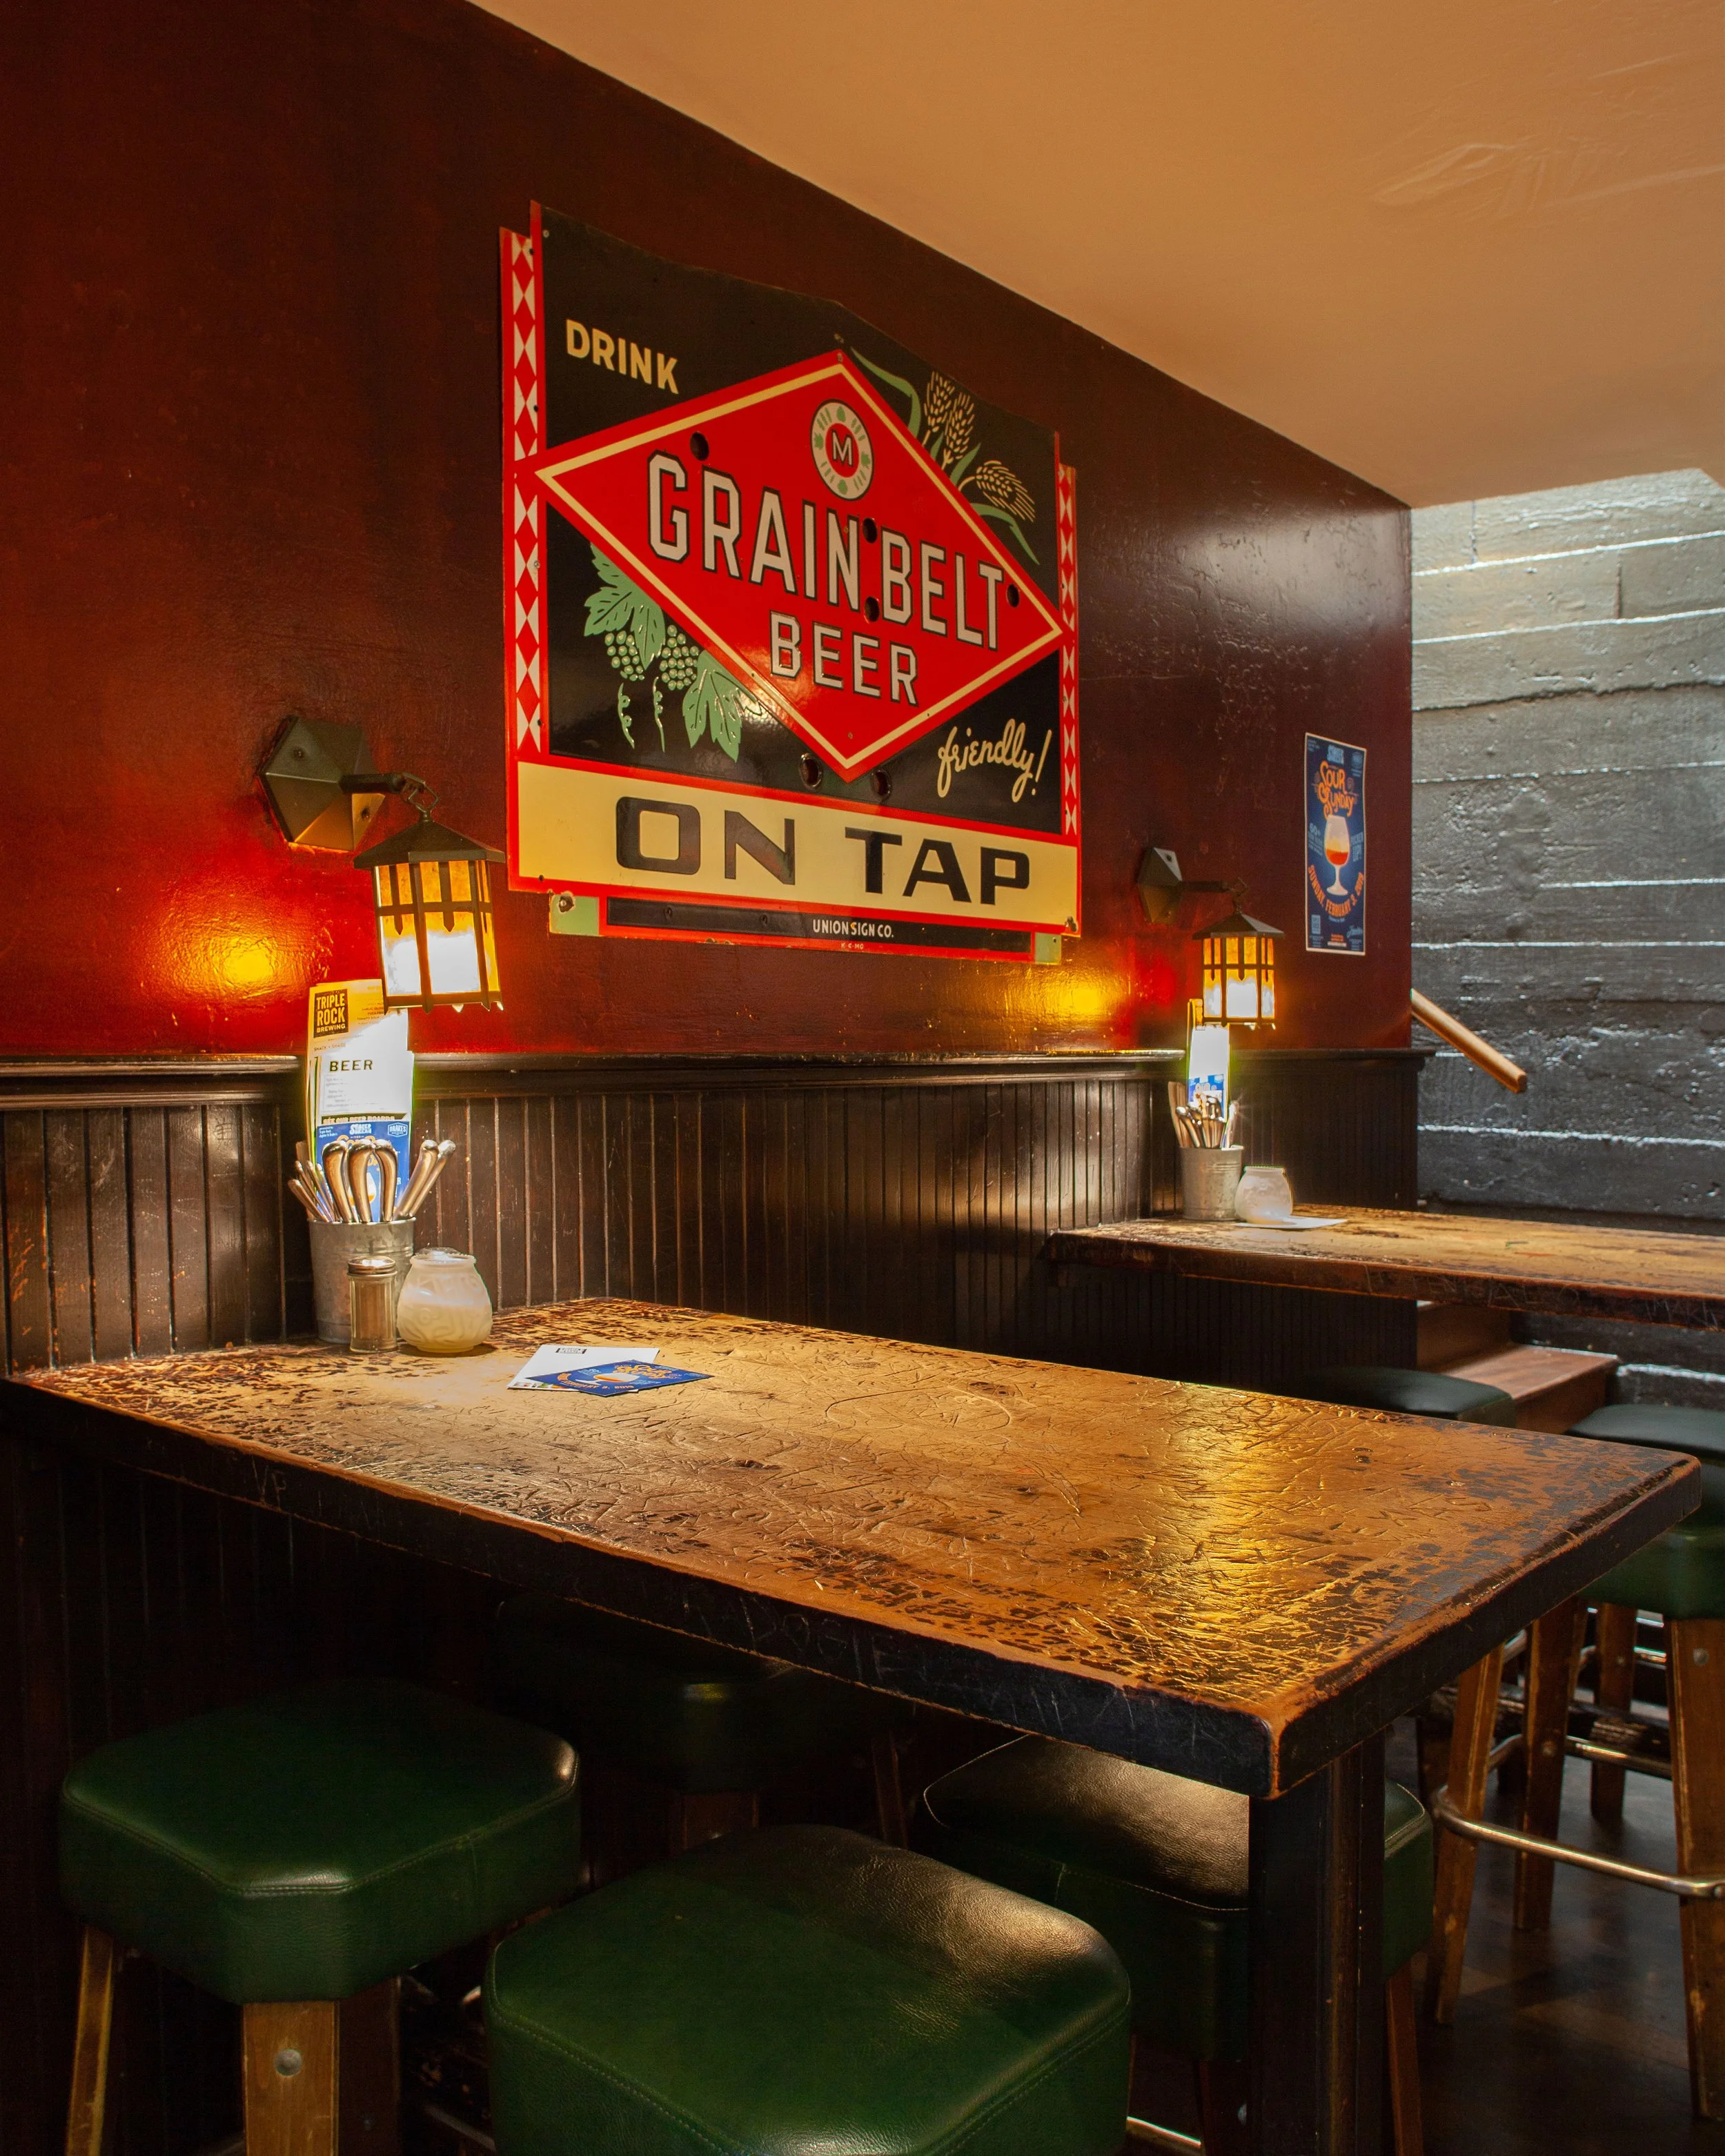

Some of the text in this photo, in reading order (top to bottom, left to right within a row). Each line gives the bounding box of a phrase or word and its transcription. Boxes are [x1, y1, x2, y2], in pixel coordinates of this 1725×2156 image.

[566, 319, 680, 394] DRINK
[831, 428, 854, 467] M
[646, 448, 1006, 651] GRAIN BELT
[769, 610, 918, 706] BEER
[937, 718, 1053, 803] friendly!
[1320, 760, 1347, 795] SOUR
[1319, 781, 1354, 820] SUNDAY
[615, 796, 1031, 907] ON TAP
[813, 919, 894, 938] UNION SIGN CO.
[316, 993, 345, 1010] TRIPLE
[317, 1007, 346, 1027] ROCK
[317, 1023, 346, 1033] BREWING
[329, 1059, 373, 1072] BEER
